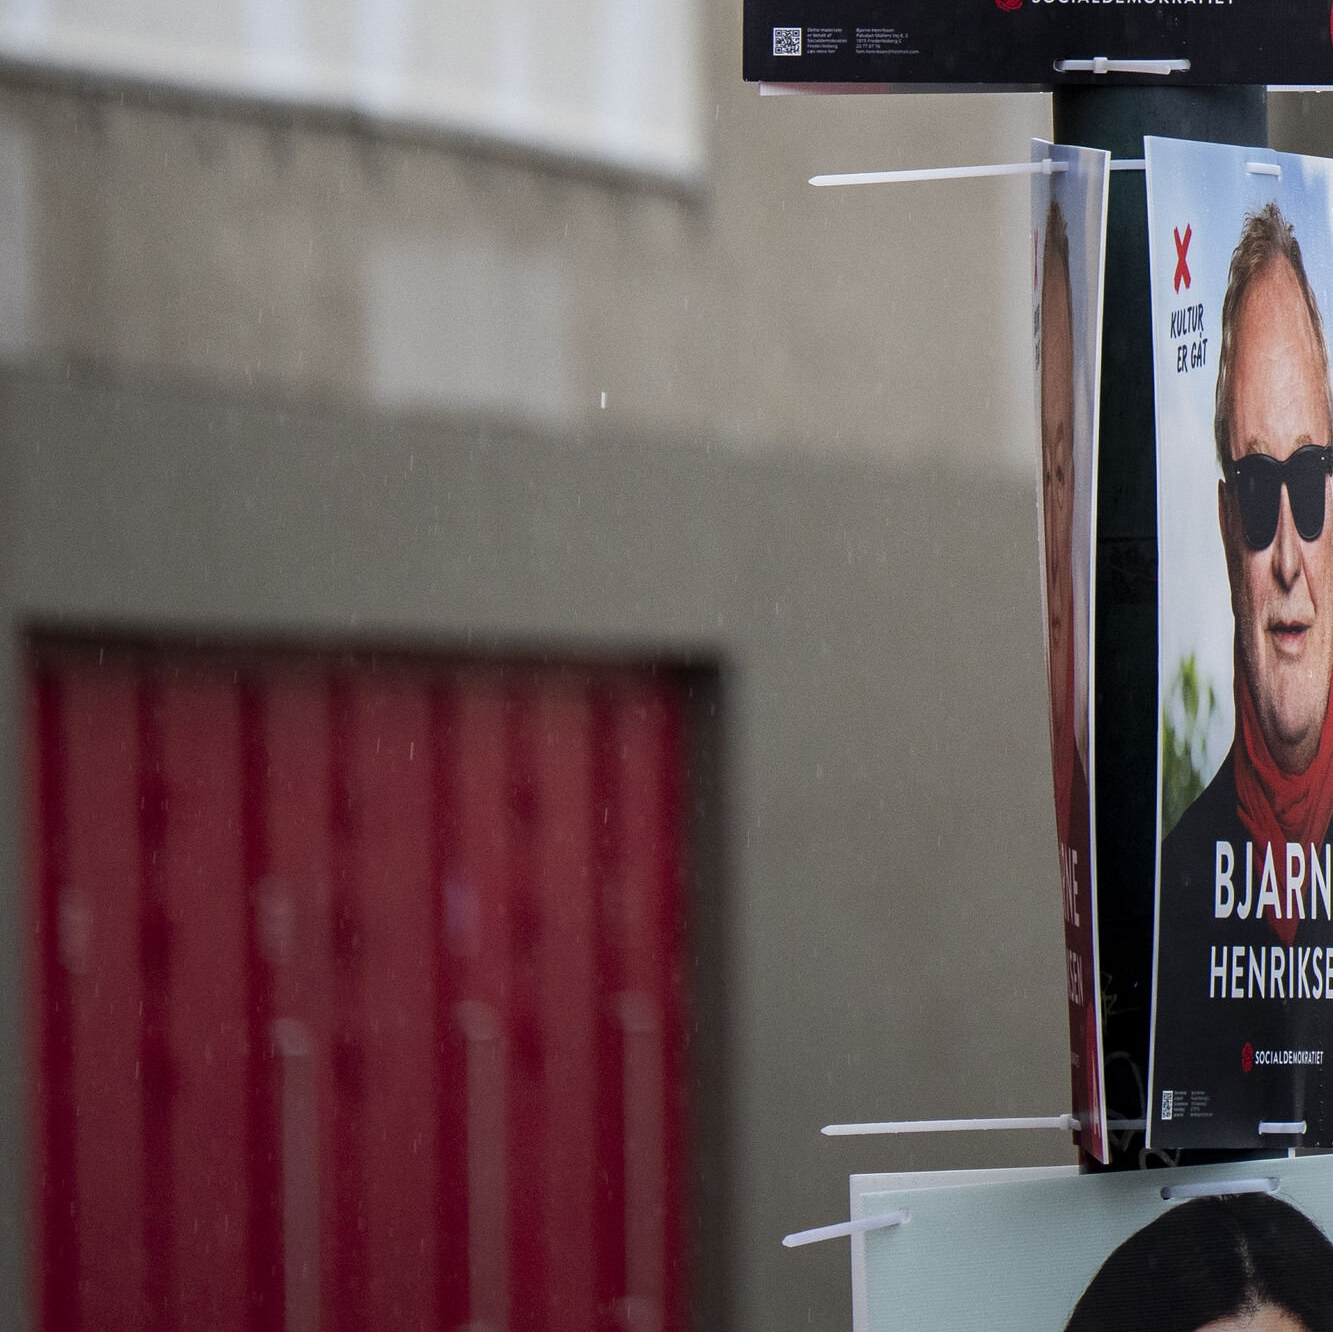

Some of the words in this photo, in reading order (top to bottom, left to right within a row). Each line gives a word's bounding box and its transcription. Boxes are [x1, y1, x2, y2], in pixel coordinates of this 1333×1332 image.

[1170, 303, 1204, 339] KULTUR
[1177, 344, 1188, 374] ER
[1254, 1049, 1324, 1066] SOCIALDEMOKRATIET
